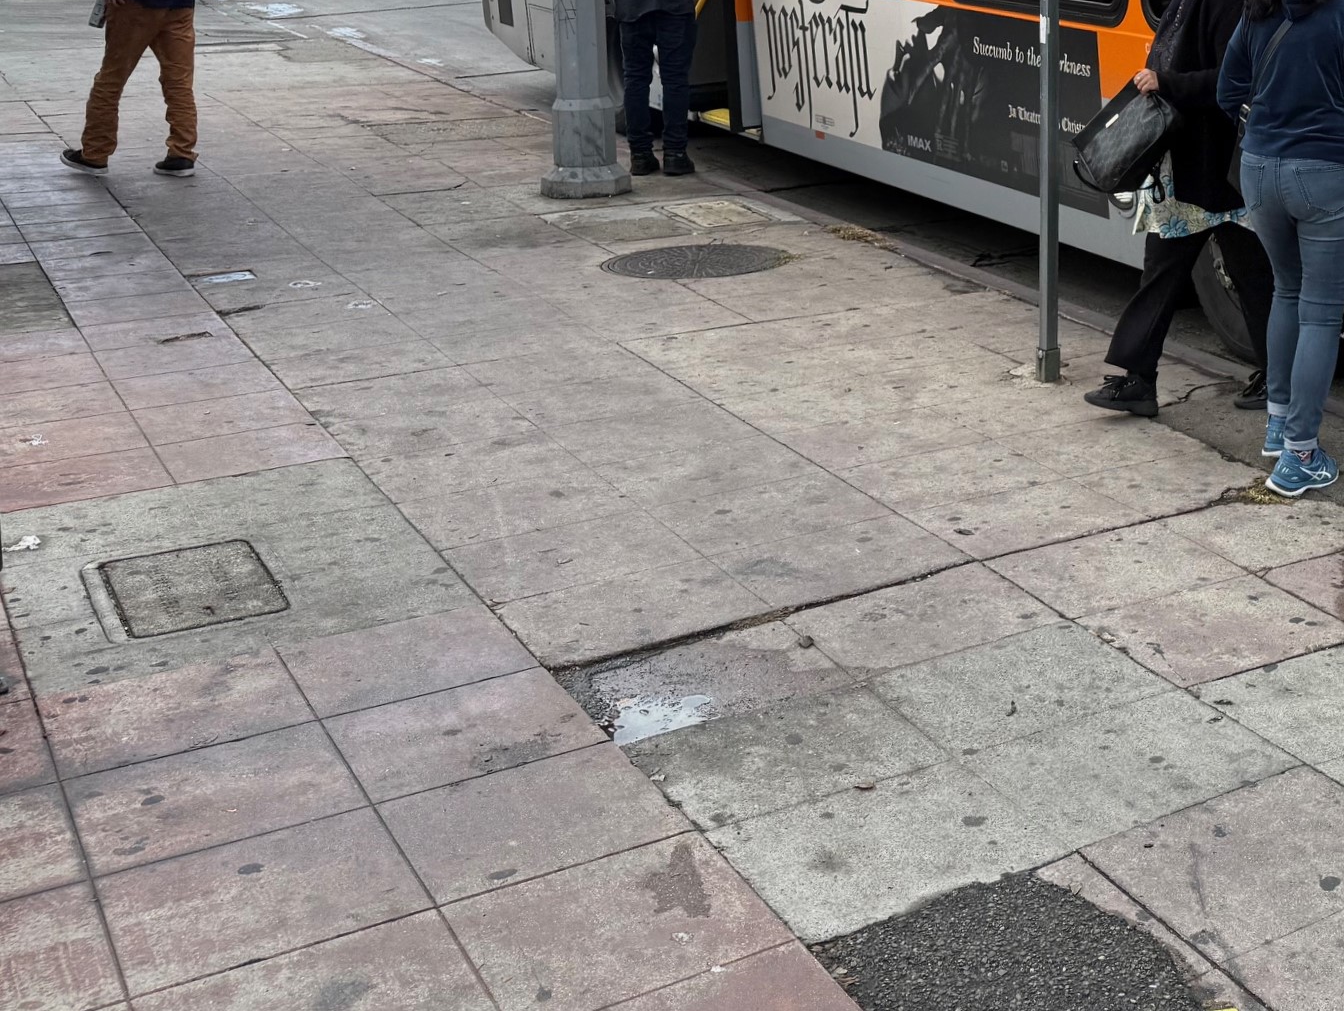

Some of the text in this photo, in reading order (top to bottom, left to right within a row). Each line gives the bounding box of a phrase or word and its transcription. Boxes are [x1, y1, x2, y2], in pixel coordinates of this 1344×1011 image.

[973, 36, 1091, 77] Succumb to the rkness
[907, 135, 932, 153] IMAX
